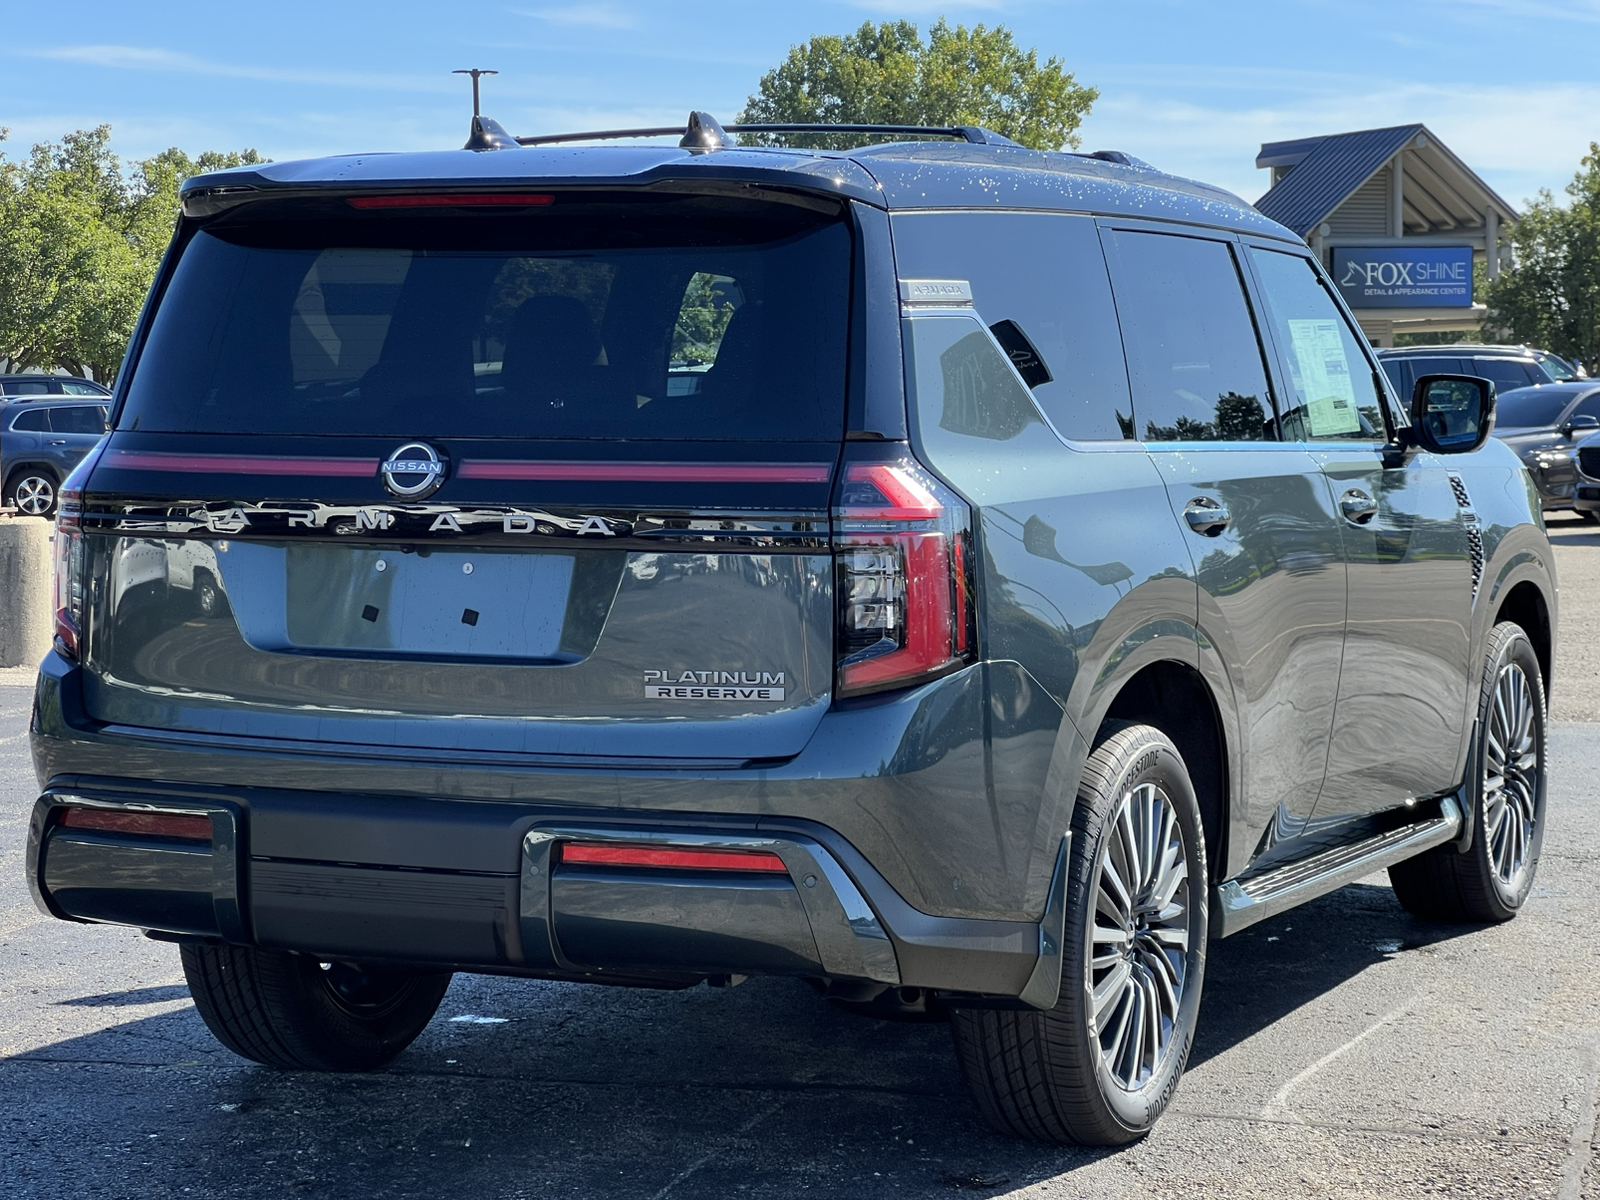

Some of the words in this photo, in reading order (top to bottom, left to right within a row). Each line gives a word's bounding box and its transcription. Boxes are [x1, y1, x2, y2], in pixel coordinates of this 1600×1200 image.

[1365, 262, 1414, 286] FOX
[1416, 262, 1466, 280] SHINE
[1394, 288, 1439, 296] APPEARANCE
[1440, 287, 1466, 295] CENTER
[382, 462, 440, 472] NISSAN
[219, 507, 616, 536] ARMADA
[643, 670, 785, 685] PLATINUM
[657, 687, 771, 699] RESERVE
